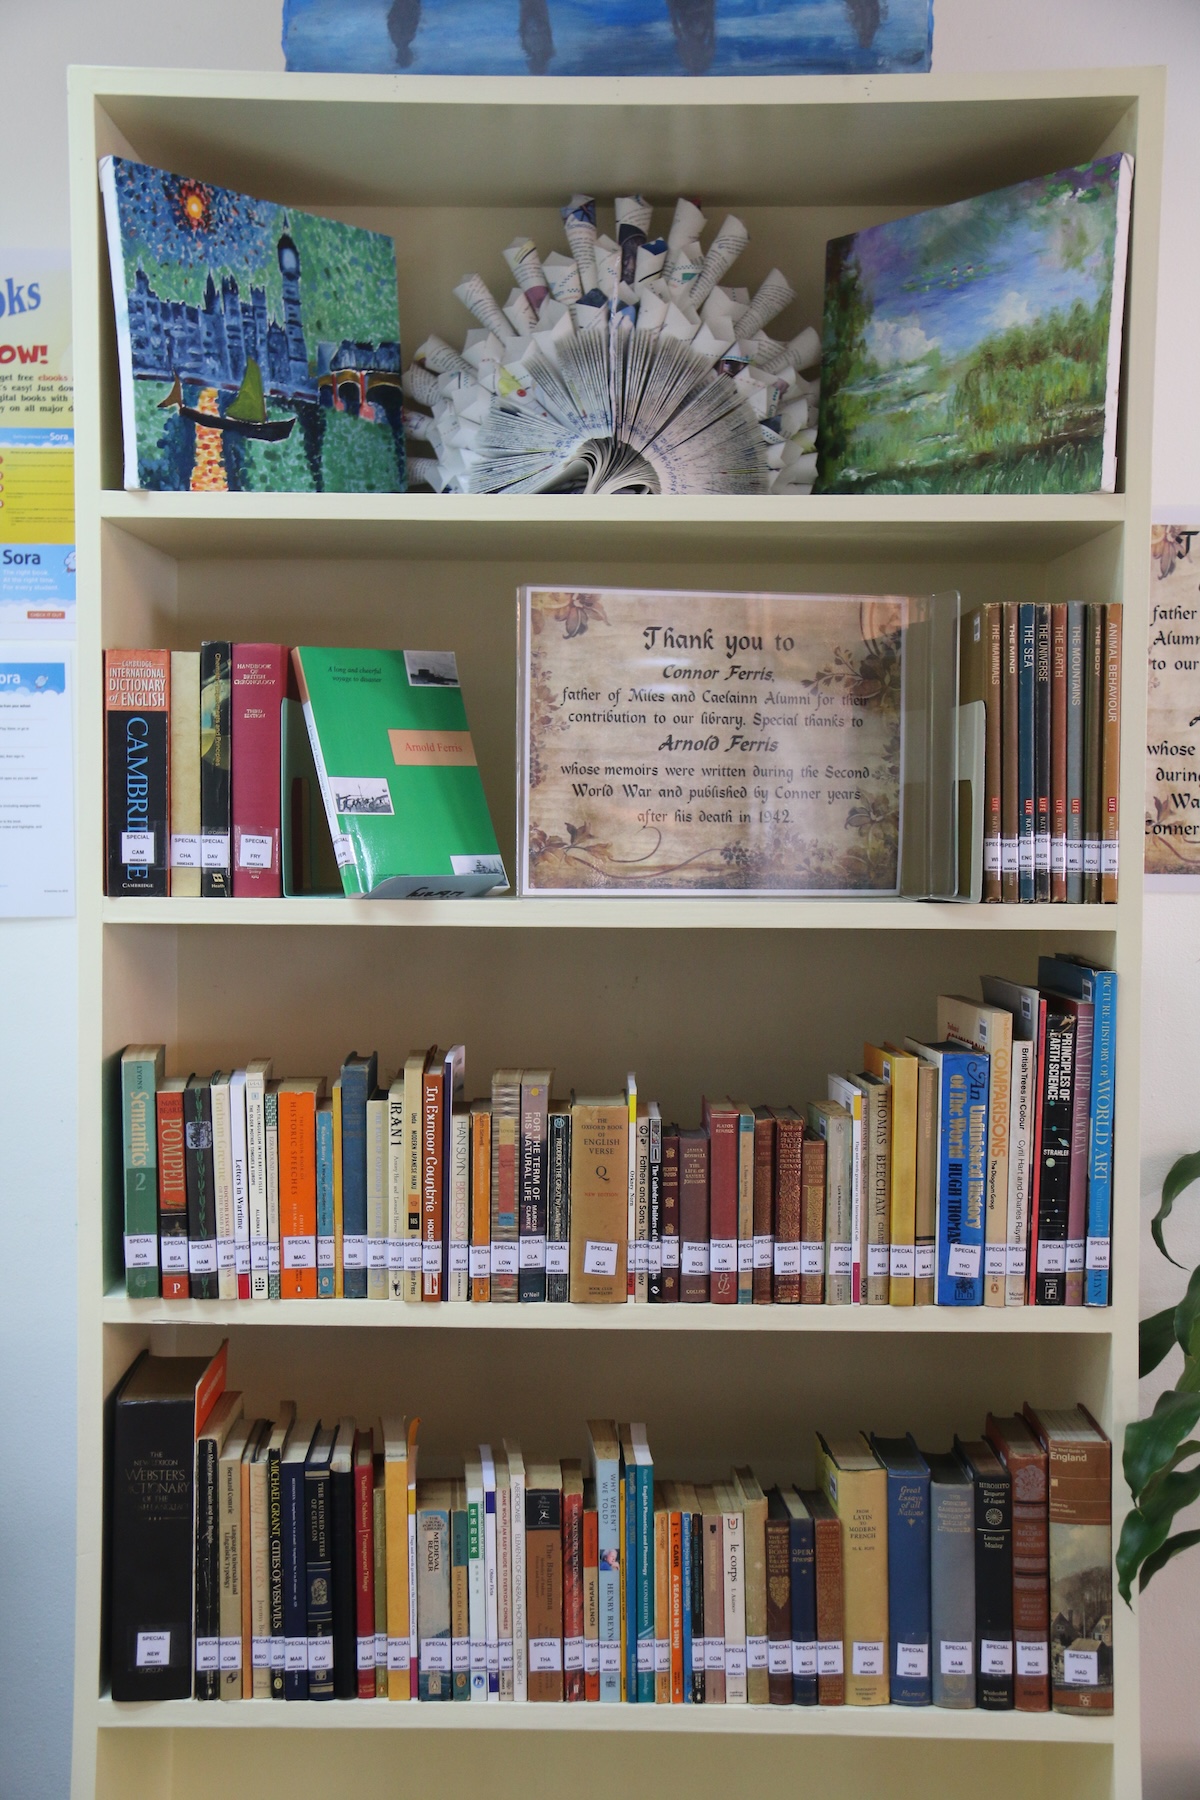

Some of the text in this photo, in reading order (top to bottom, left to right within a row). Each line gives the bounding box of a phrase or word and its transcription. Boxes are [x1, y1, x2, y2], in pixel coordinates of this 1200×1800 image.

[20, 394, 68, 403] books with
[24, 404, 35, 412] all
[39, 404, 64, 414] major
[2, 549, 41, 565] Sora
[1150, 604, 1197, 627] father
[643, 626, 795, 659] Thank you to
[1008, 623, 1016, 674] THE MIND
[1023, 623, 1034, 668] THE SEA
[1038, 622, 1049, 682] THE UNIVERSE
[1054, 625, 1064, 678] THE EARTH
[109, 667, 166, 679] INTERNATIONAL
[333, 666, 346, 675] long
[347, 666, 358, 674] and
[359, 666, 382, 675] cheerful
[662, 664, 775, 682] Connor Ferris,
[1071, 626, 1082, 706] THE MOUNTAINS
[1107, 622, 1118, 722] ANIMAL BEHAVIOUR
[1151, 658, 1200, 671] to our
[109, 679, 167, 692] DICTIONARY
[560, 687, 870, 711] father of Miles and Caelainn Alumni for their
[108, 692, 166, 707] of ENGLISH
[568, 710, 864, 732] contribution to our library. Special thanks to
[404, 742, 463, 753] Arnold Ferris
[658, 734, 779, 752] Arnold Ferris
[560, 761, 870, 783] whose memoirs were written during the Second
[571, 783, 862, 805] World War and published by Conner years
[1025, 799, 1033, 814] LIFE
[637, 808, 794, 829] after his death in 1942.
[1021, 1047, 1029, 1073] British
[1059, 1032, 1073, 1100] PRINCIPLES OF
[950, 1074, 965, 1089] of
[1020, 1073, 1028, 1095] Trees
[1047, 1059, 1059, 1100] SCIENCE
[1094, 975, 1112, 1184] PICTURE HISTORY OF WORLD ART
[991, 1048, 1009, 1158] COMPARISONS
[129, 1091, 150, 1167] Semantics
[390, 1101, 403, 1138] IRAN
[425, 1105, 439, 1155] Exmoor
[1019, 1104, 1028, 1130] Colour
[289, 1101, 298, 1196] HISTORIC SPEECHES
[583, 1138, 620, 1146] ENGLISH
[948, 1117, 966, 1160] World
[964, 1061, 987, 1230] An Unfinished History
[161, 1118, 185, 1193] POMPEII
[523, 1112, 533, 1202] HIS NATURAL LIFE
[532, 1112, 541, 1201] FOR THE TERM OF
[876, 1090, 888, 1217] THOMAS BEECHAM
[425, 1156, 438, 1213] Countrie
[595, 1165, 610, 1182] Q
[237, 1196, 245, 1230] Wartime
[1050, 1452, 1088, 1463] England
[270, 1459, 281, 1499] MICHAEL
[602, 1481, 608, 1494] WE
[978, 1481, 1010, 1489] HIROHITO
[271, 1539, 281, 1568] CITIES
[728, 1543, 740, 1582] le corps
[272, 1583, 283, 1629] VESUVIUS
